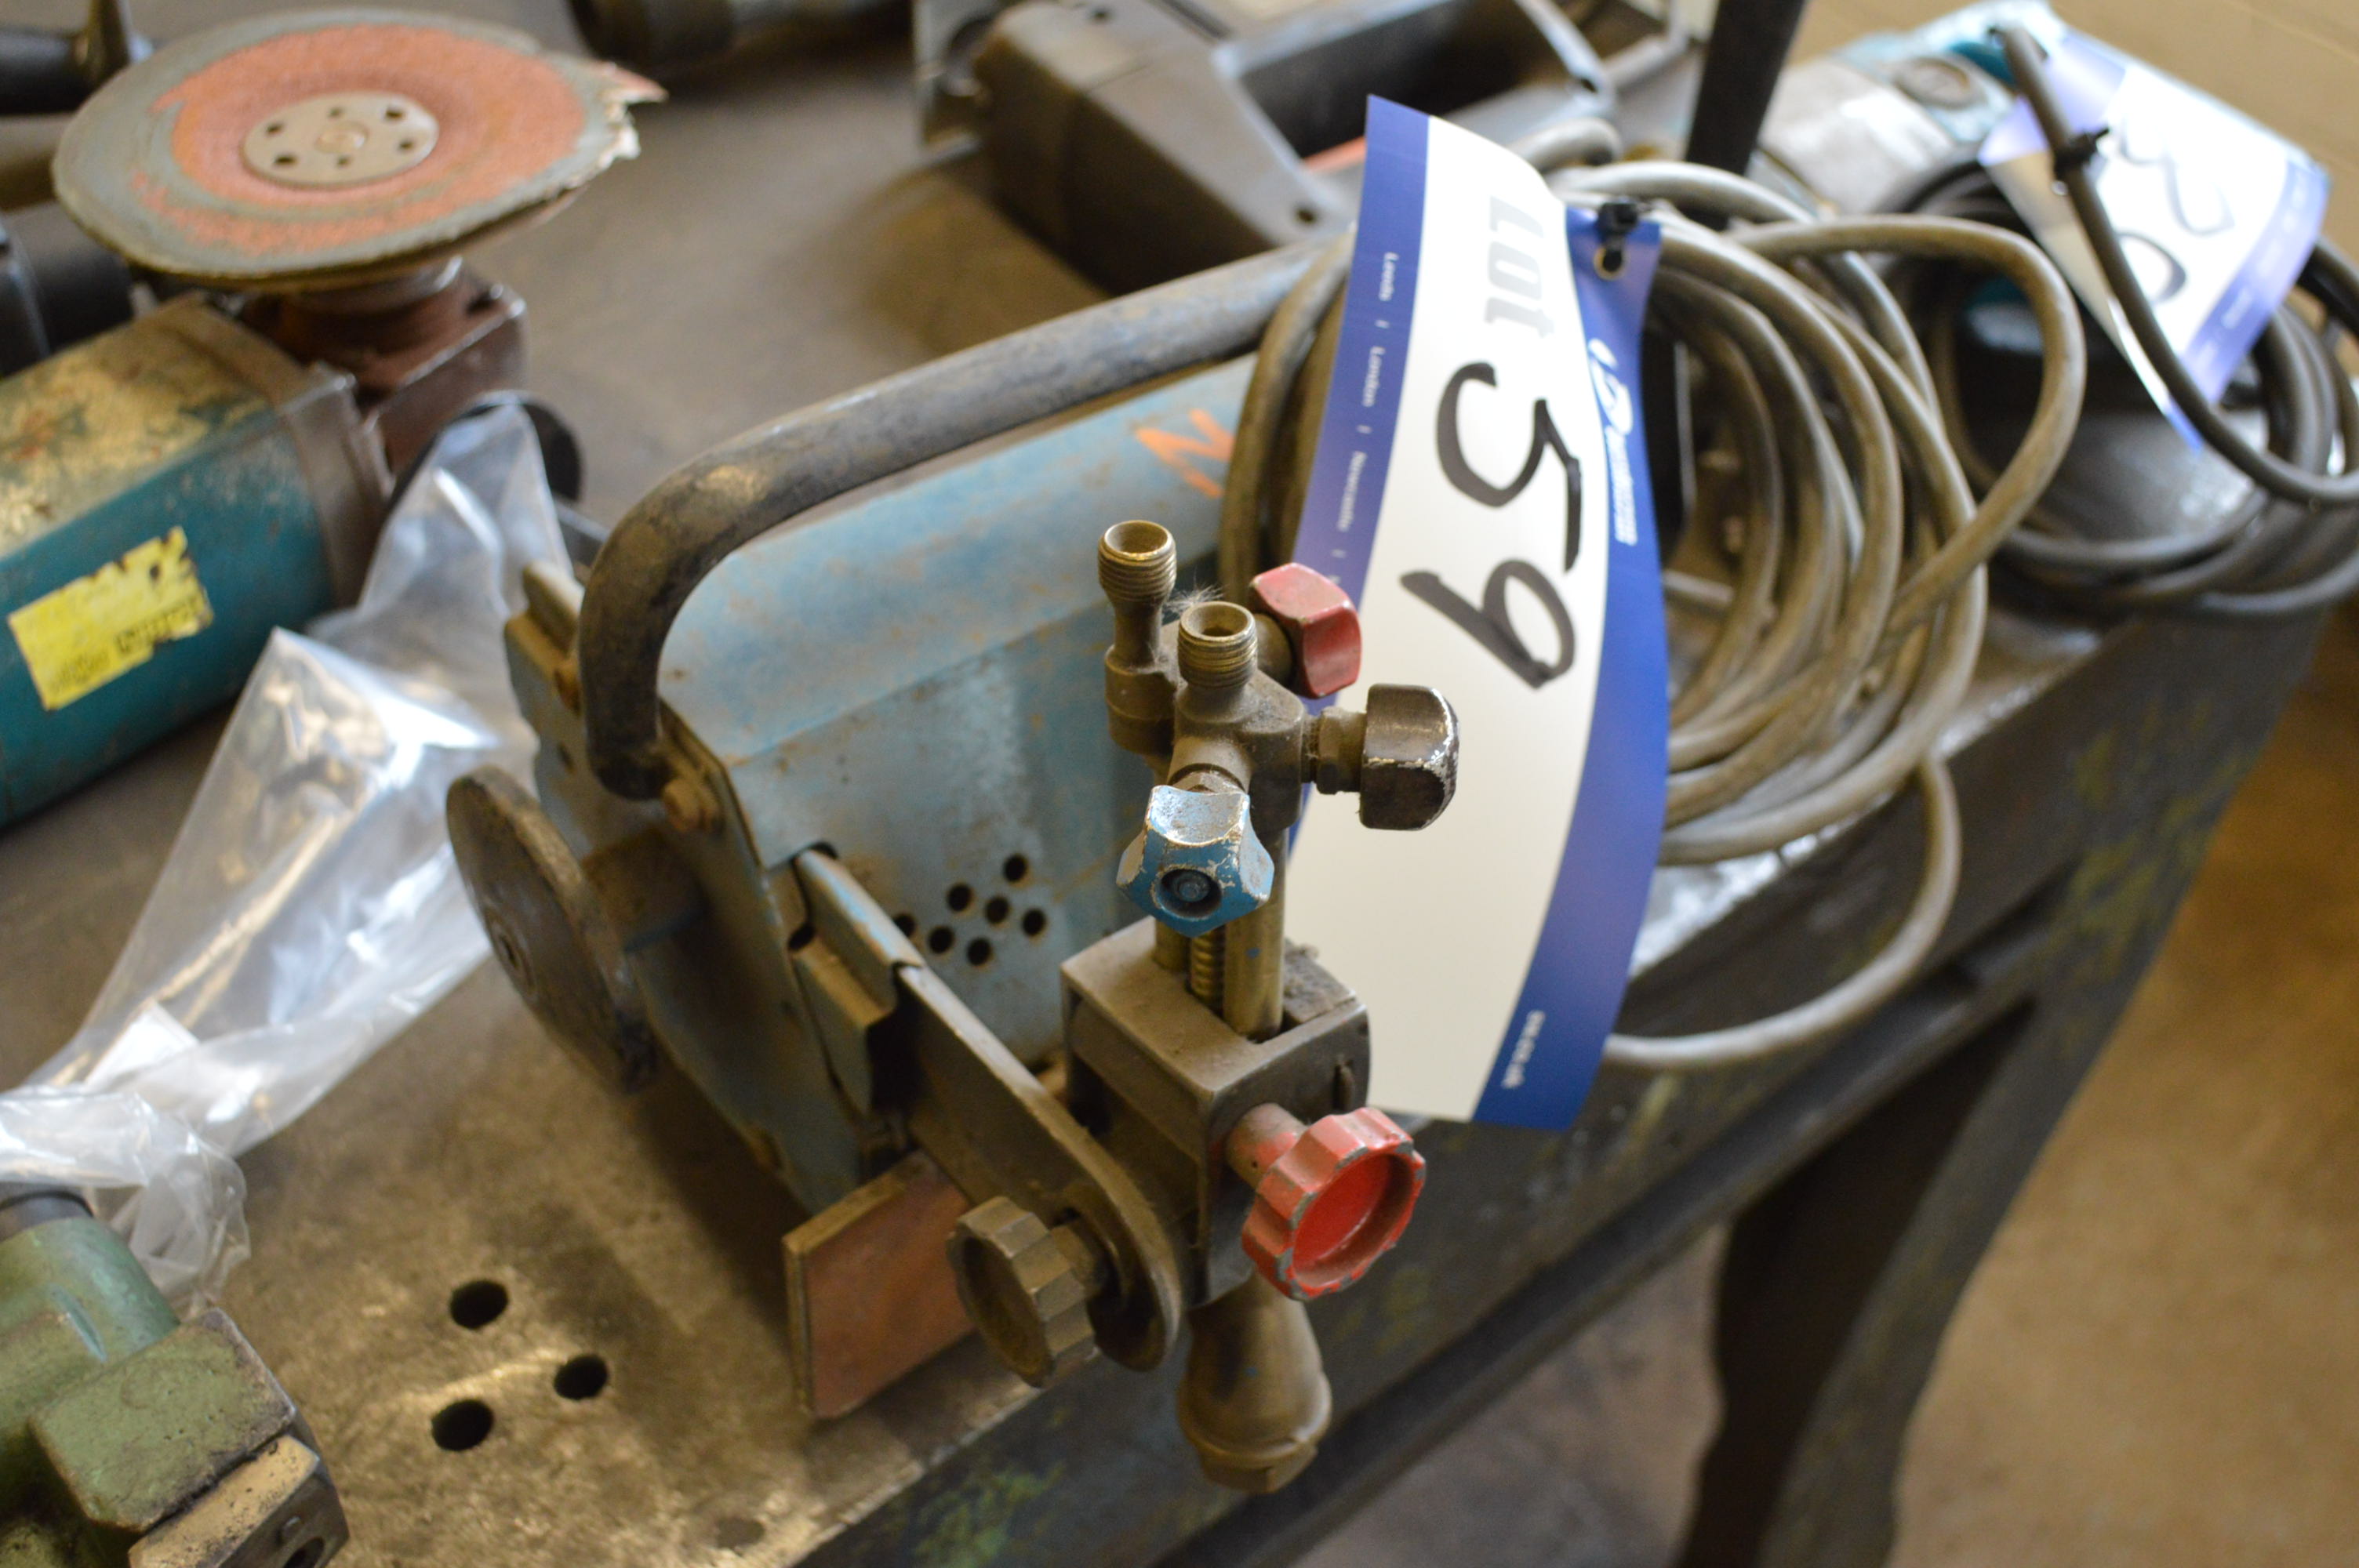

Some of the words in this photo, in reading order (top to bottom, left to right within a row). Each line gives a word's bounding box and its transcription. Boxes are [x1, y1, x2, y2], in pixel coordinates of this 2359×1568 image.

[1379, 252, 1399, 302] Leeds
[1484, 195, 1555, 339] Lot
[1361, 346, 1386, 408] London
[1398, 362, 1583, 688] 59
